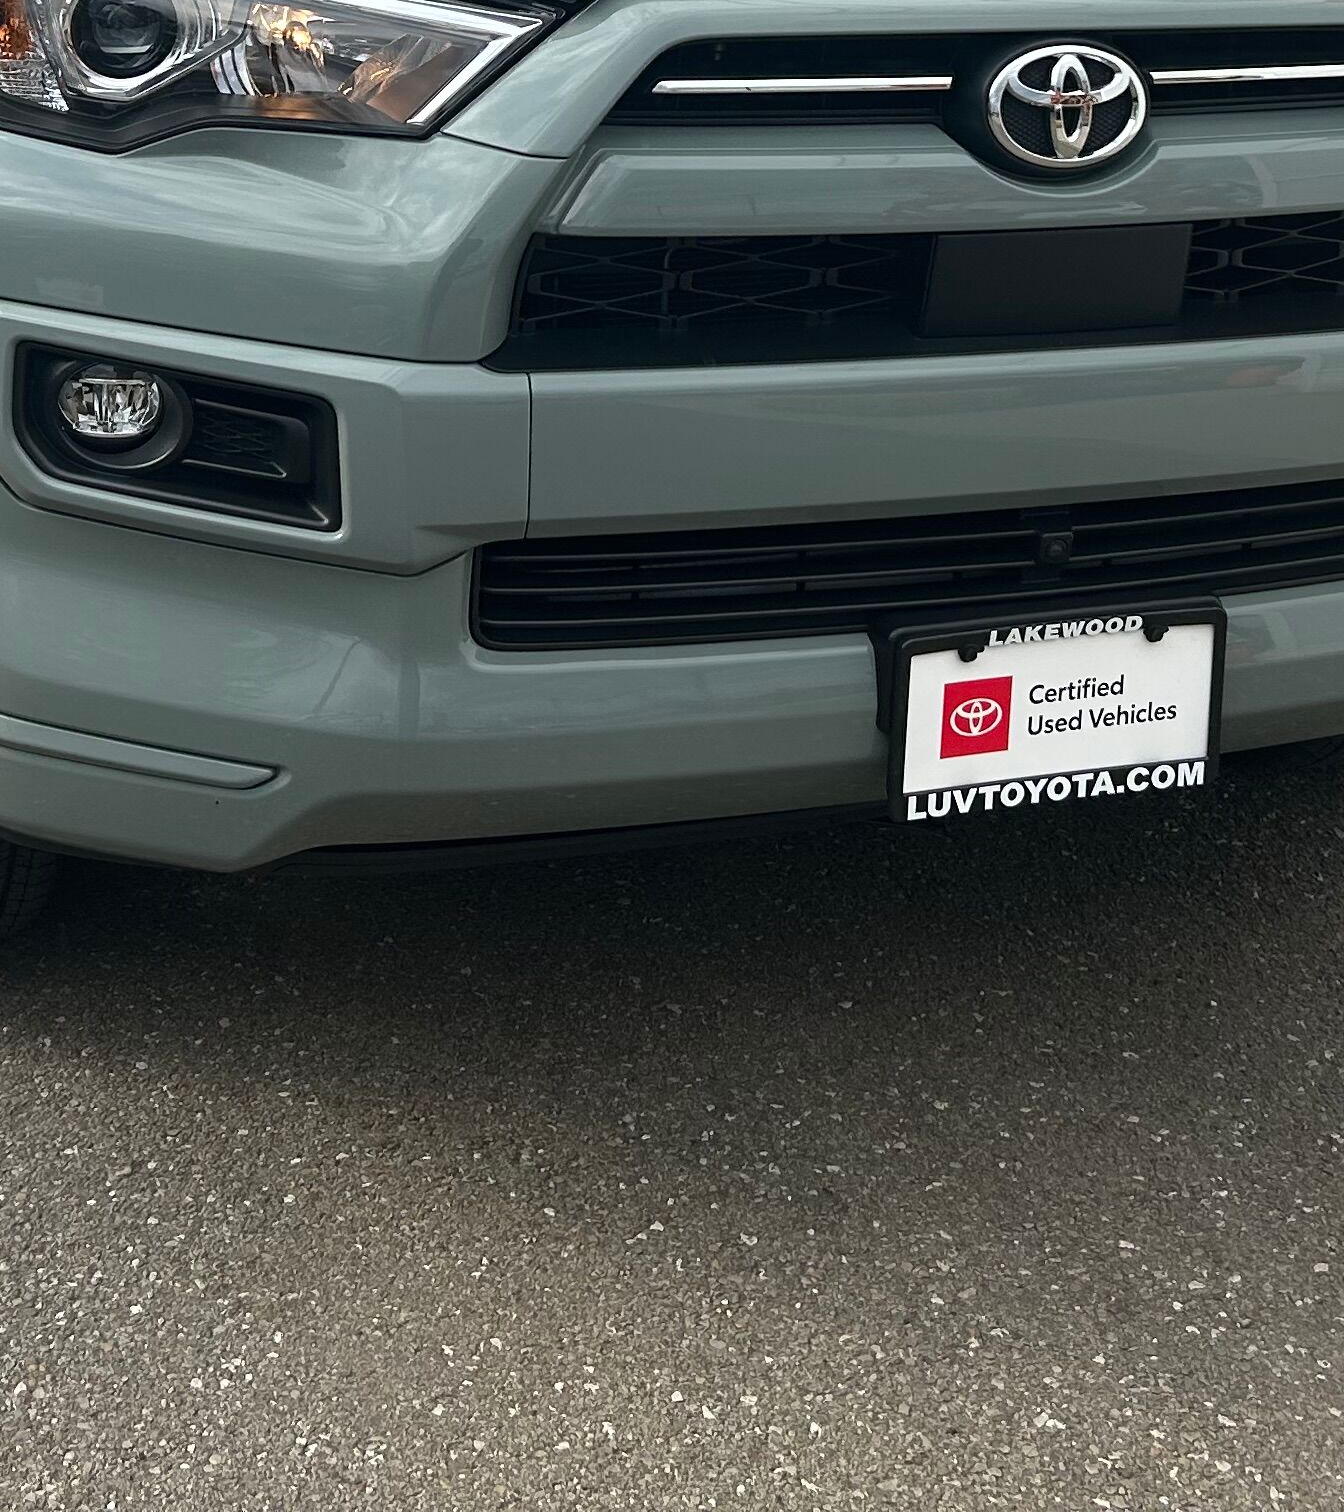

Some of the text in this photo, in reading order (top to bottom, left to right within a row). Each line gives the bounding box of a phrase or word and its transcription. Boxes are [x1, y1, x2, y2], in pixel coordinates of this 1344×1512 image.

[988, 614, 1144, 648] LAKEWOOD
[1029, 674, 1125, 705] Certified
[1027, 701, 1178, 736] Used Vehicles
[906, 760, 1205, 822] LUVTOYOTA.COM
